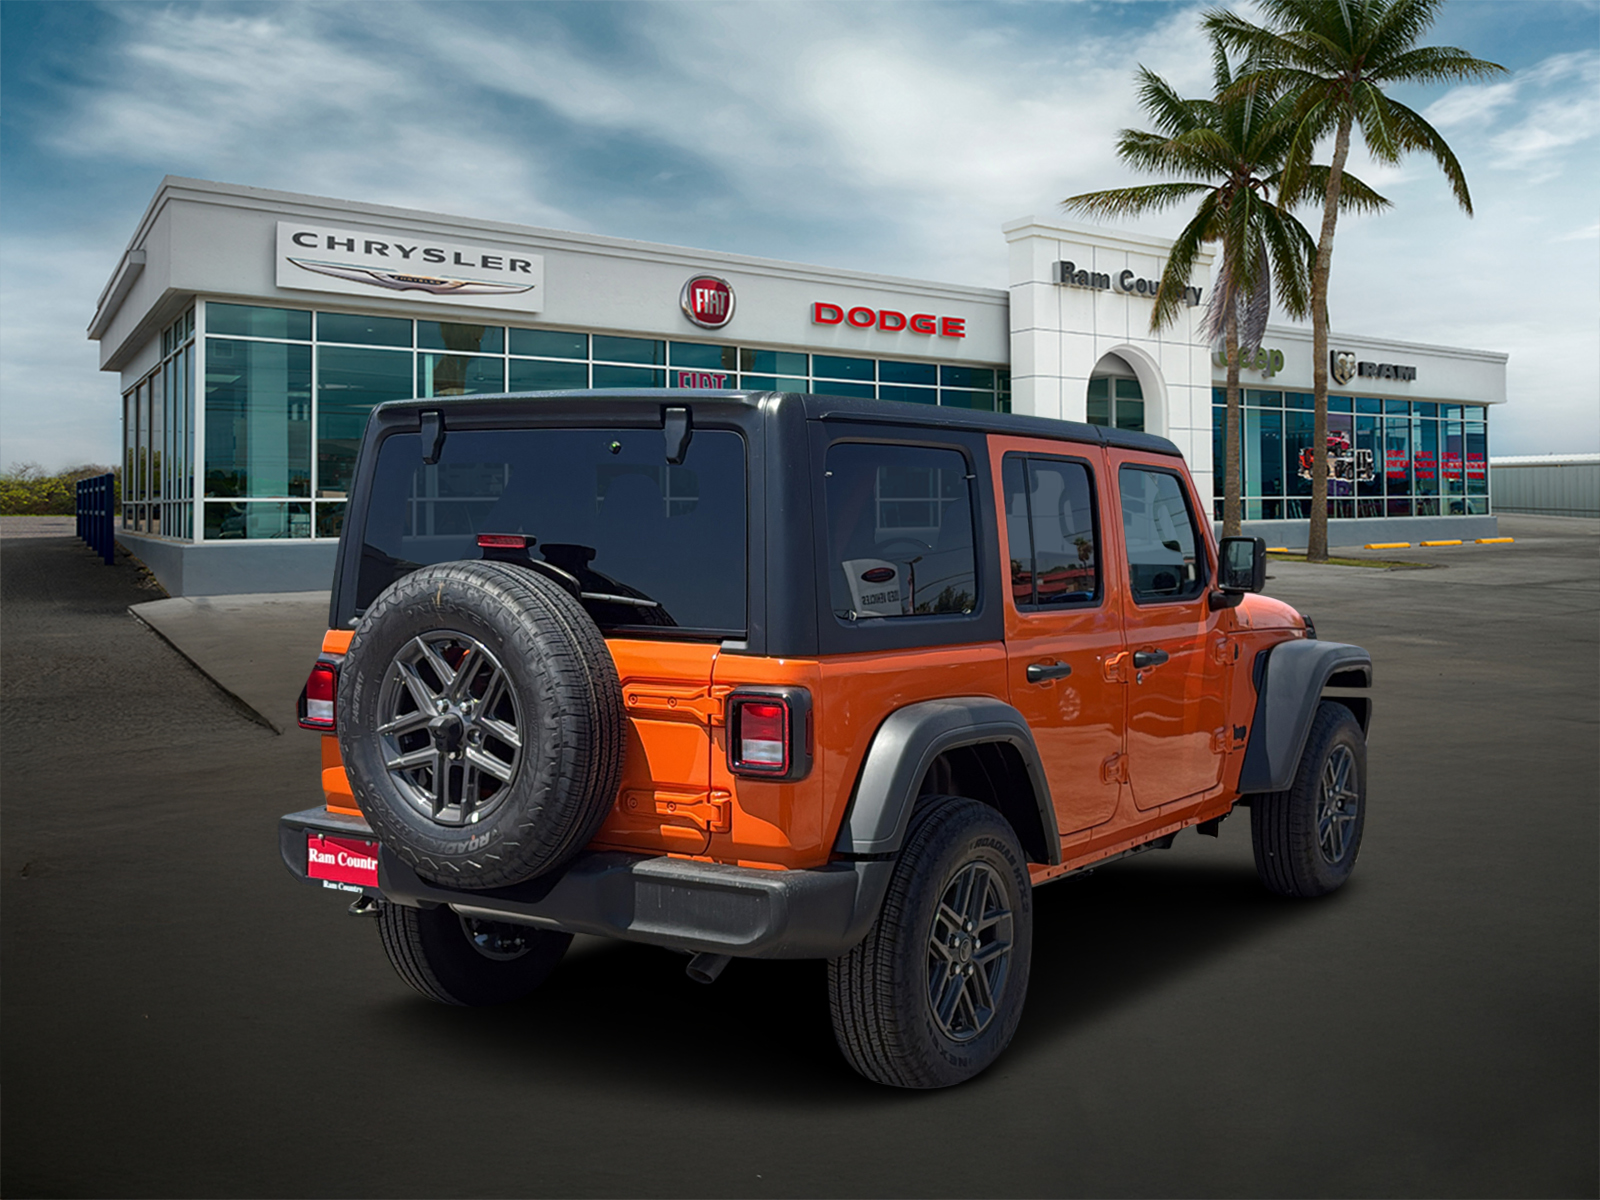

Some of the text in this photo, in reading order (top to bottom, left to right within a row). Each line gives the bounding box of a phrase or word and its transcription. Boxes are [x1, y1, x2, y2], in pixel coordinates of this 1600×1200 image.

[291, 231, 533, 274] CHRYSLER
[1052, 260, 1203, 307] Ram Coury
[695, 288, 728, 316] FIAT
[811, 301, 966, 339] DODGE
[1357, 361, 1417, 381] RAM
[309, 848, 378, 870] Ram Countr
[323, 880, 363, 893] Ram Country
